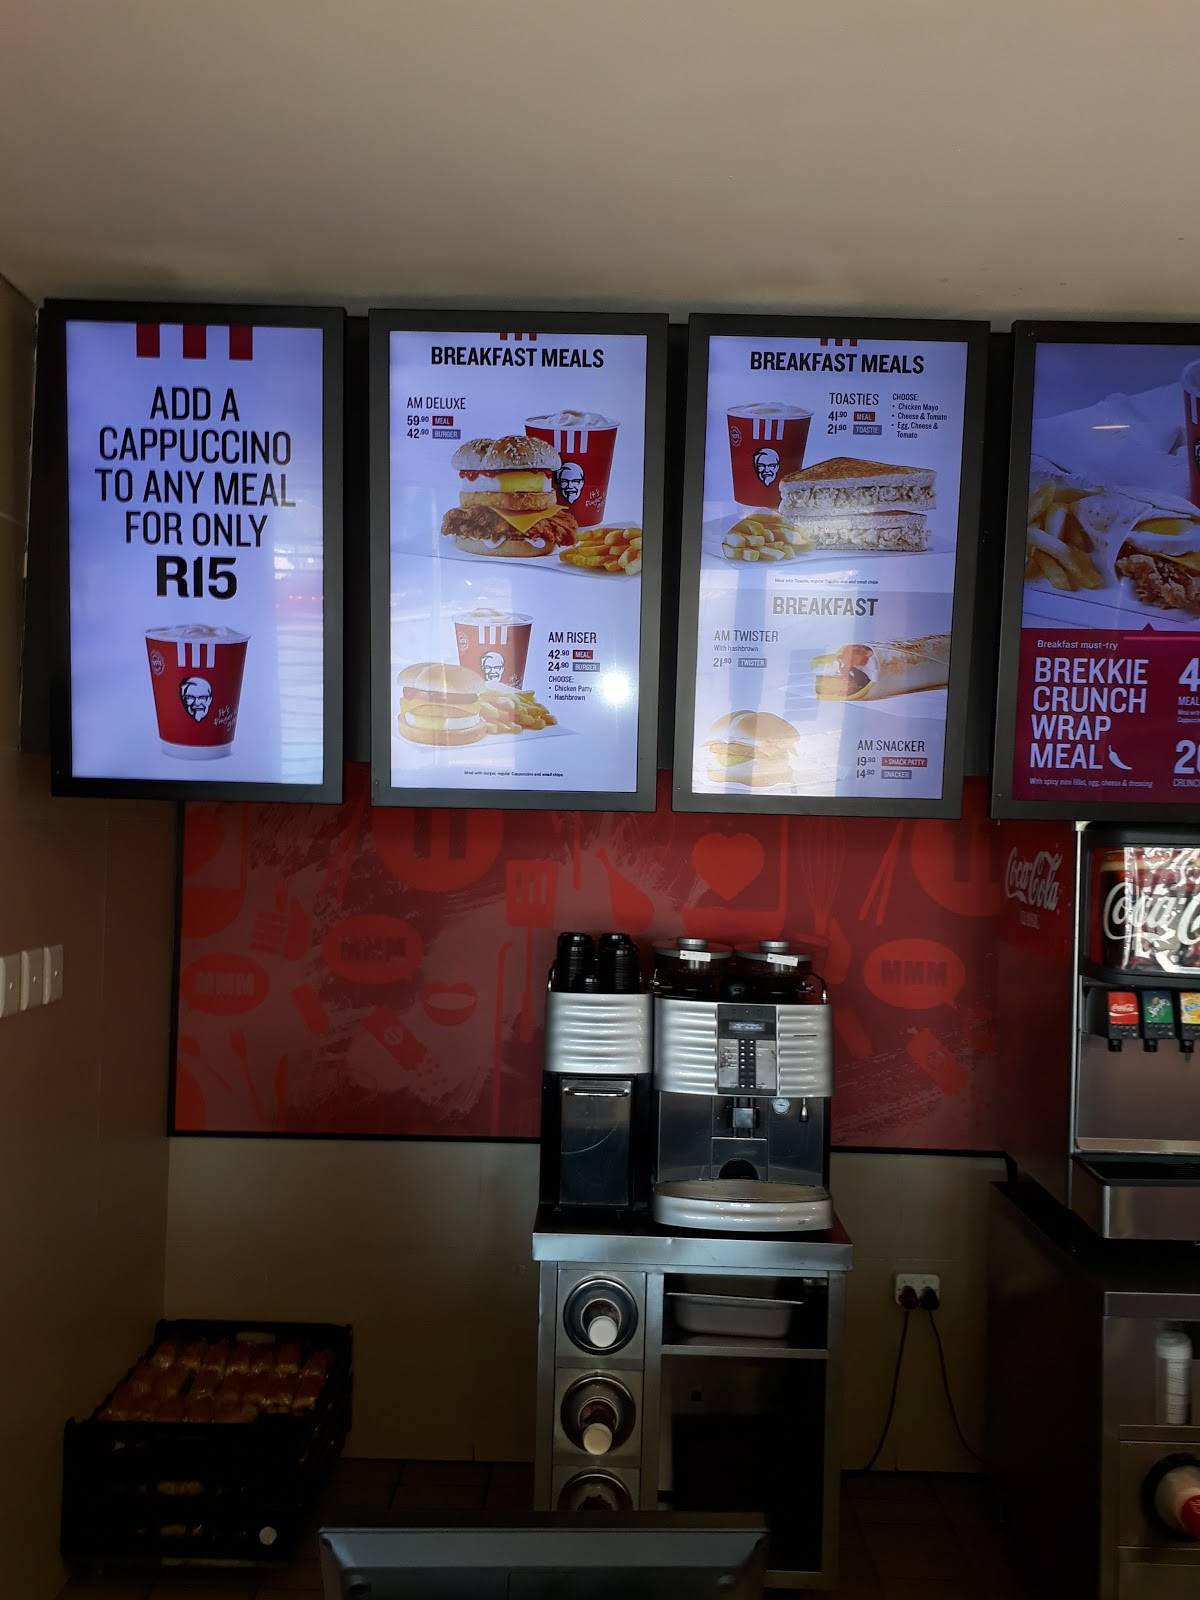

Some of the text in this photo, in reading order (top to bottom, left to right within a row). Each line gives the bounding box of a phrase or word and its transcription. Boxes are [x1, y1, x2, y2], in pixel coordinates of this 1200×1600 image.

[431, 346, 604, 368] BREAKFAST MEALS
[750, 351, 925, 374] BREAKFAST MEALS
[150, 386, 240, 422] ADD A
[406, 396, 466, 410] AM DELUXE
[829, 392, 880, 406] TOASTIES
[898, 402, 939, 412] Chicken Mayo
[434, 417, 450, 425] MEAL
[856, 412, 872, 421] MEAL
[897, 412, 919, 420] Cheese
[926, 413, 948, 421] Tomato
[434, 430, 458, 438] BURGER
[897, 430, 918, 439] Tomato
[910, 422, 932, 430] Cheese
[99, 426, 292, 466] CAPPUCCINO
[95, 468, 296, 508] TO ANY MEAL
[125, 511, 268, 548] FOR ONLY
[156, 555, 238, 600] R15
[772, 596, 879, 617] BREAKFAST
[548, 631, 597, 644] AM RISER
[714, 630, 778, 642] AM TWISTER
[1037, 639, 1078, 648] Breakfast
[1034, 656, 1149, 685] BREKKIE
[1032, 685, 1147, 714] CRUNCH
[1178, 696, 1200, 706] MEAL
[1031, 714, 1112, 741] WRAP
[857, 740, 925, 752] AM SNACKER
[1030, 742, 1104, 770] MEAL
[1174, 740, 1200, 774] 2
[880, 960, 948, 985] MMM
